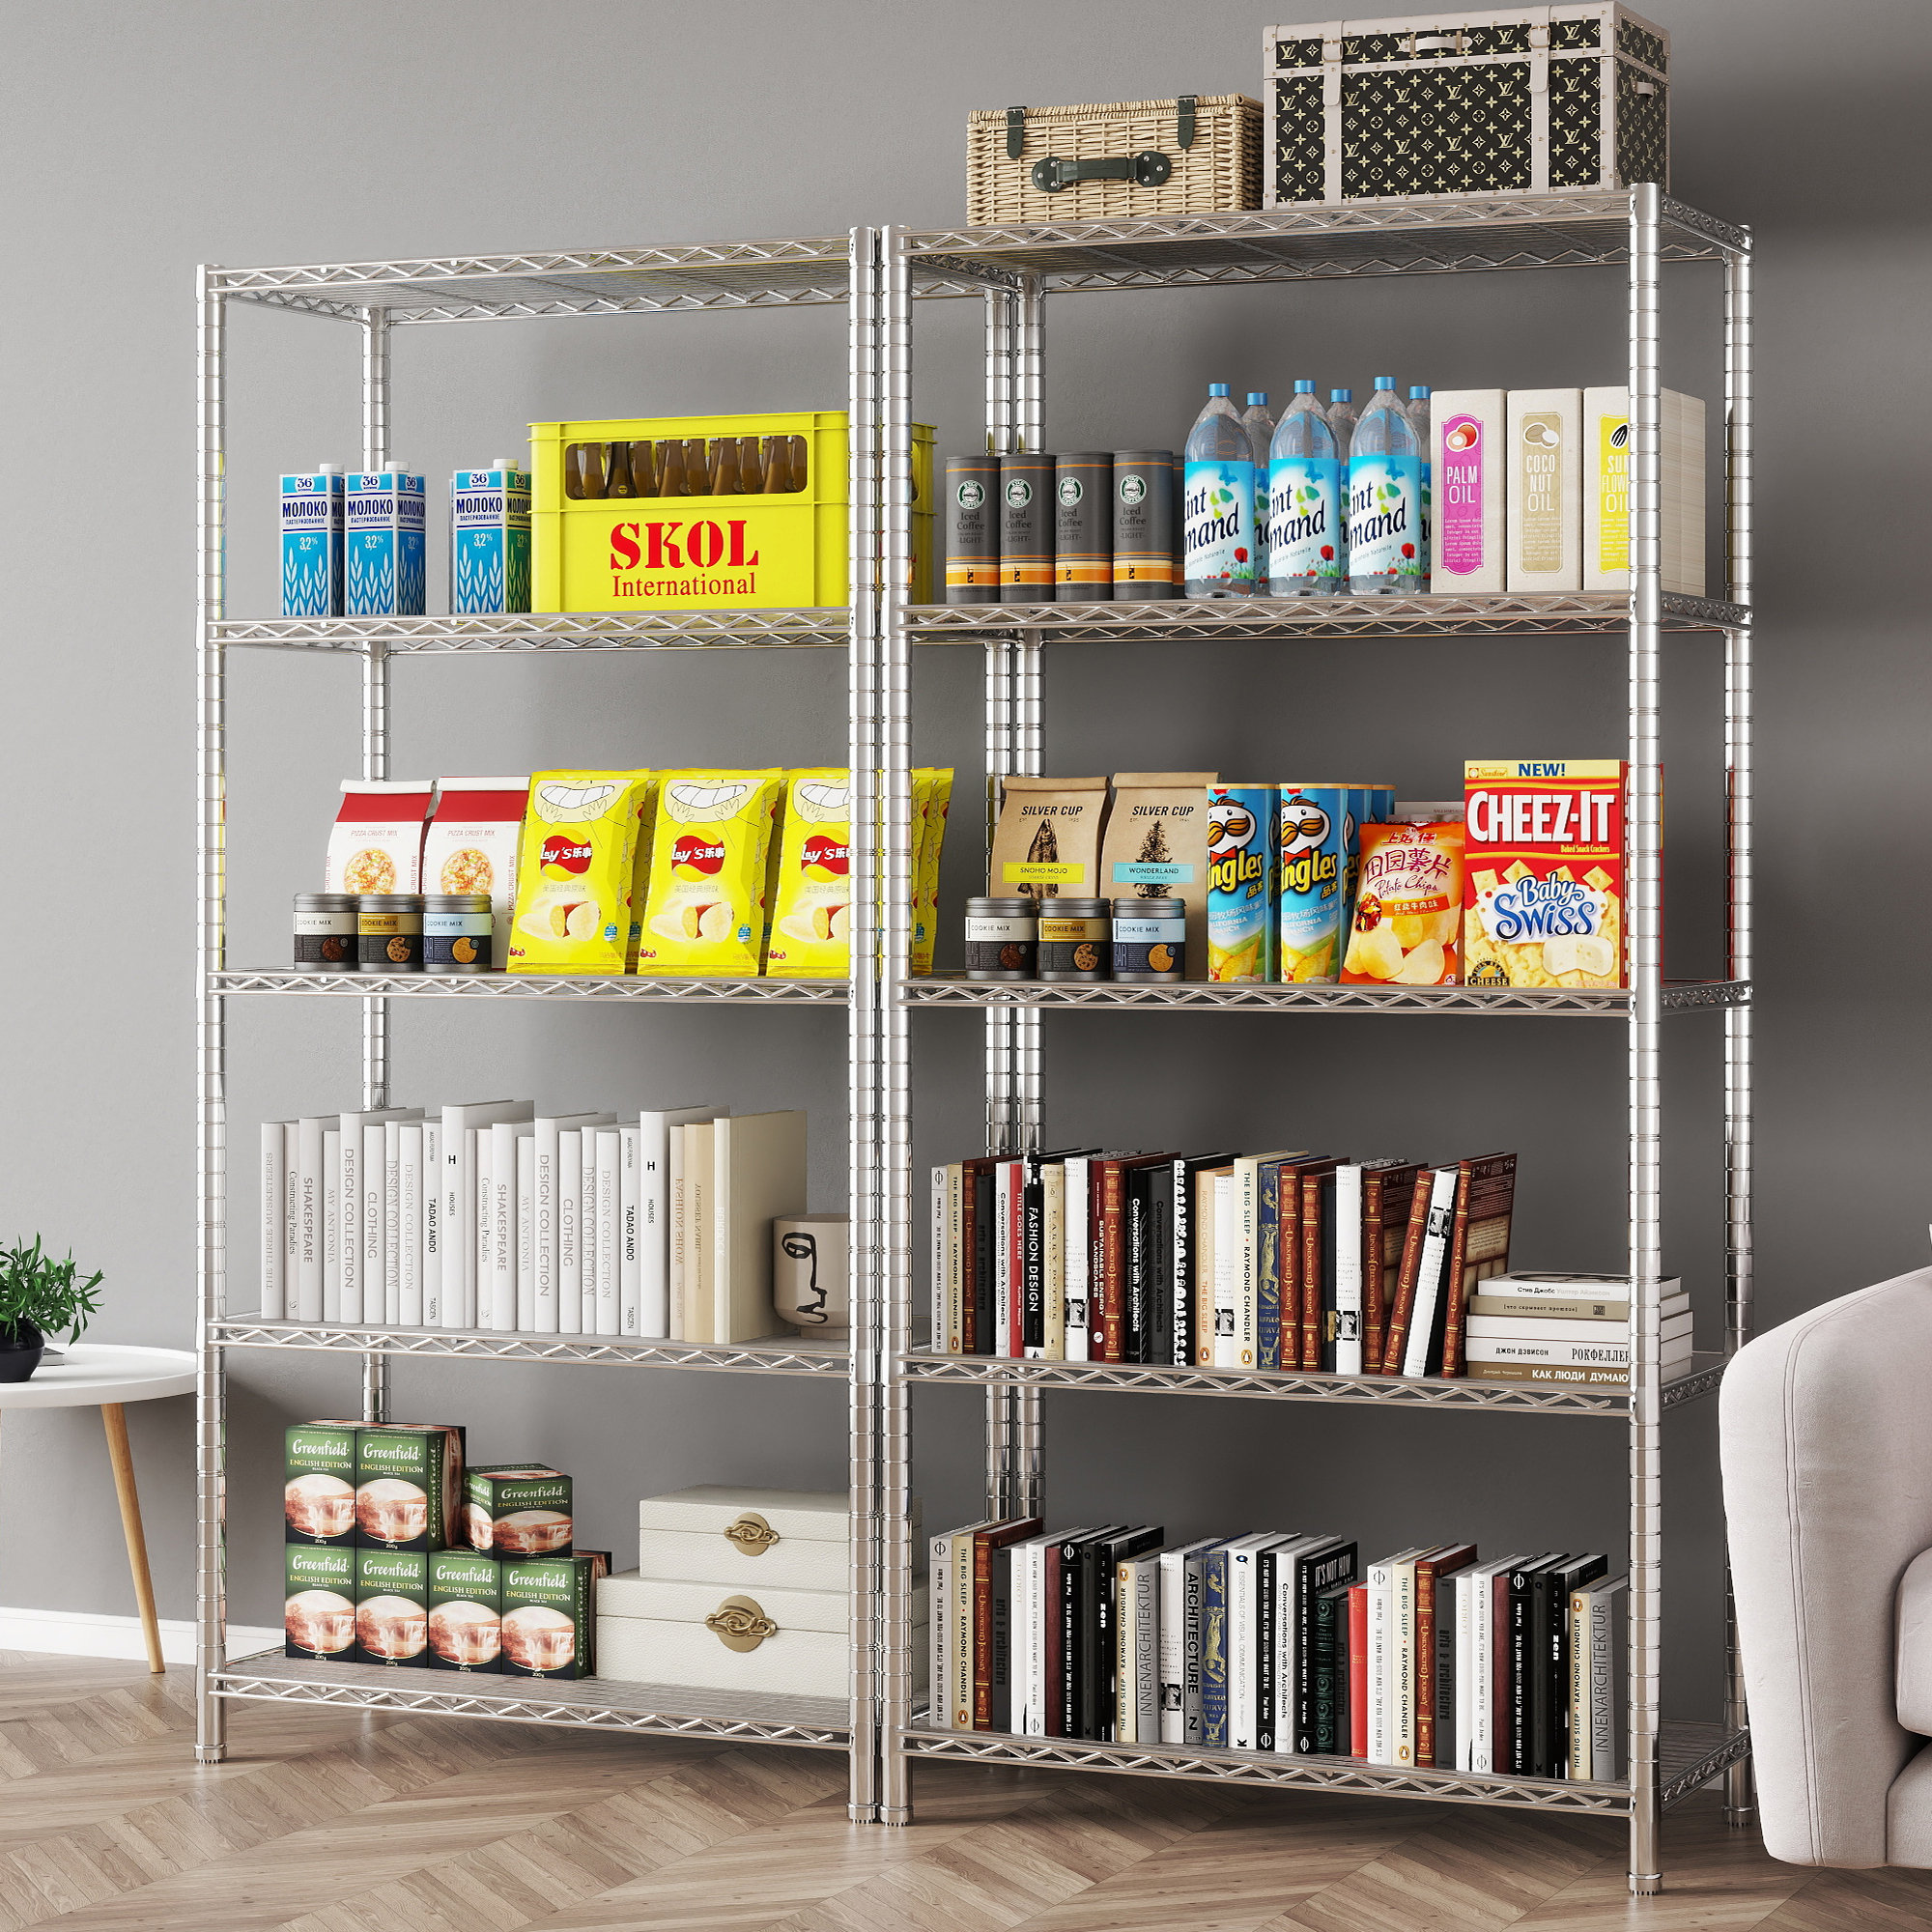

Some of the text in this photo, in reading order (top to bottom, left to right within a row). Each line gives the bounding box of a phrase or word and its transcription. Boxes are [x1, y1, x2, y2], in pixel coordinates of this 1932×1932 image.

[1526, 455, 1555, 472] COCO
[298, 478, 312, 488] 36
[362, 476, 379, 486] 36
[471, 473, 487, 484] 36
[1447, 466, 1478, 484] PALM
[1530, 474, 1552, 492] NUT
[1270, 483, 1293, 519] int
[1449, 485, 1476, 503] OIL
[1528, 494, 1554, 511] OIL
[282, 500, 327, 518] МОЛОКО
[348, 498, 393, 516] МОЛОКО
[397, 499, 425, 518] МОЛОКО
[456, 497, 502, 514] МОЛОКО
[1009, 510, 1026, 519] Iced
[1122, 506, 1141, 516] Iced
[957, 521, 984, 530] Coffee
[960, 512, 980, 521] Iced
[1006, 520, 1032, 528] Coffee
[1120, 516, 1146, 526] Coffee
[610, 520, 758, 570] SKOL
[612, 573, 756, 597] International
[1518, 763, 1565, 777] NEW!
[1021, 806, 1083, 815] SILVER CUP
[1132, 806, 1194, 816] SILVER CUP
[1467, 790, 1615, 843] CHEEZ-IT
[1560, 844, 1610, 853] Baked Snack Crackers
[1363, 847, 1452, 884] 田园薯片
[1375, 875, 1439, 898] Potato Chips
[1516, 871, 1585, 907] Baby
[1394, 899, 1439, 911] 红烧牛肉味
[1469, 978, 1508, 986] CHEESE
[288, 1171, 298, 1220] Constructing
[327, 1189, 335, 1207] MY
[303, 1178, 313, 1263] SHAKESPEARE
[345, 1149, 354, 1288] DESIGN COLLECTION
[367, 1192, 378, 1259] CLOTHING
[386, 1160, 398, 1287] DESIGN COLLECTION
[497, 1184, 506, 1271] SHAKESPEARE
[539, 1154, 549, 1296] DESIGN COLLECTION
[563, 1199, 574, 1266] CLOTHING
[626, 1206, 635, 1261] TADAO ANDO
[1131, 1198, 1140, 1263] Conversations
[1029, 1207, 1038, 1312] FASHION DESIGN
[1532, 1370, 1551, 1379] КАК
[1554, 1371, 1585, 1380] ЛЮДИ
[293, 1438, 350, 1457] Greenfield
[363, 1443, 421, 1461] Greenfield
[290, 1459, 352, 1469] ENGLISH EDITION
[501, 1486, 566, 1499] Greenfield
[293, 1554, 350, 1573] Greenfield
[363, 1560, 421, 1577] Greenfield
[290, 1575, 352, 1585] ENGLISH EDITION
[436, 1565, 495, 1583] Greenfield
[509, 1571, 569, 1588] Greenfield
[434, 1585, 497, 1596] ENGLISH EDITION
[506, 1590, 571, 1602] ENGLISH EDITION
[1187, 1572, 1199, 1694] ARCHITECTURE
[1137, 1575, 1152, 1716] INNENARCHITEKTUR
[1592, 1605, 1608, 1753] INNENARCHITEKTUR
